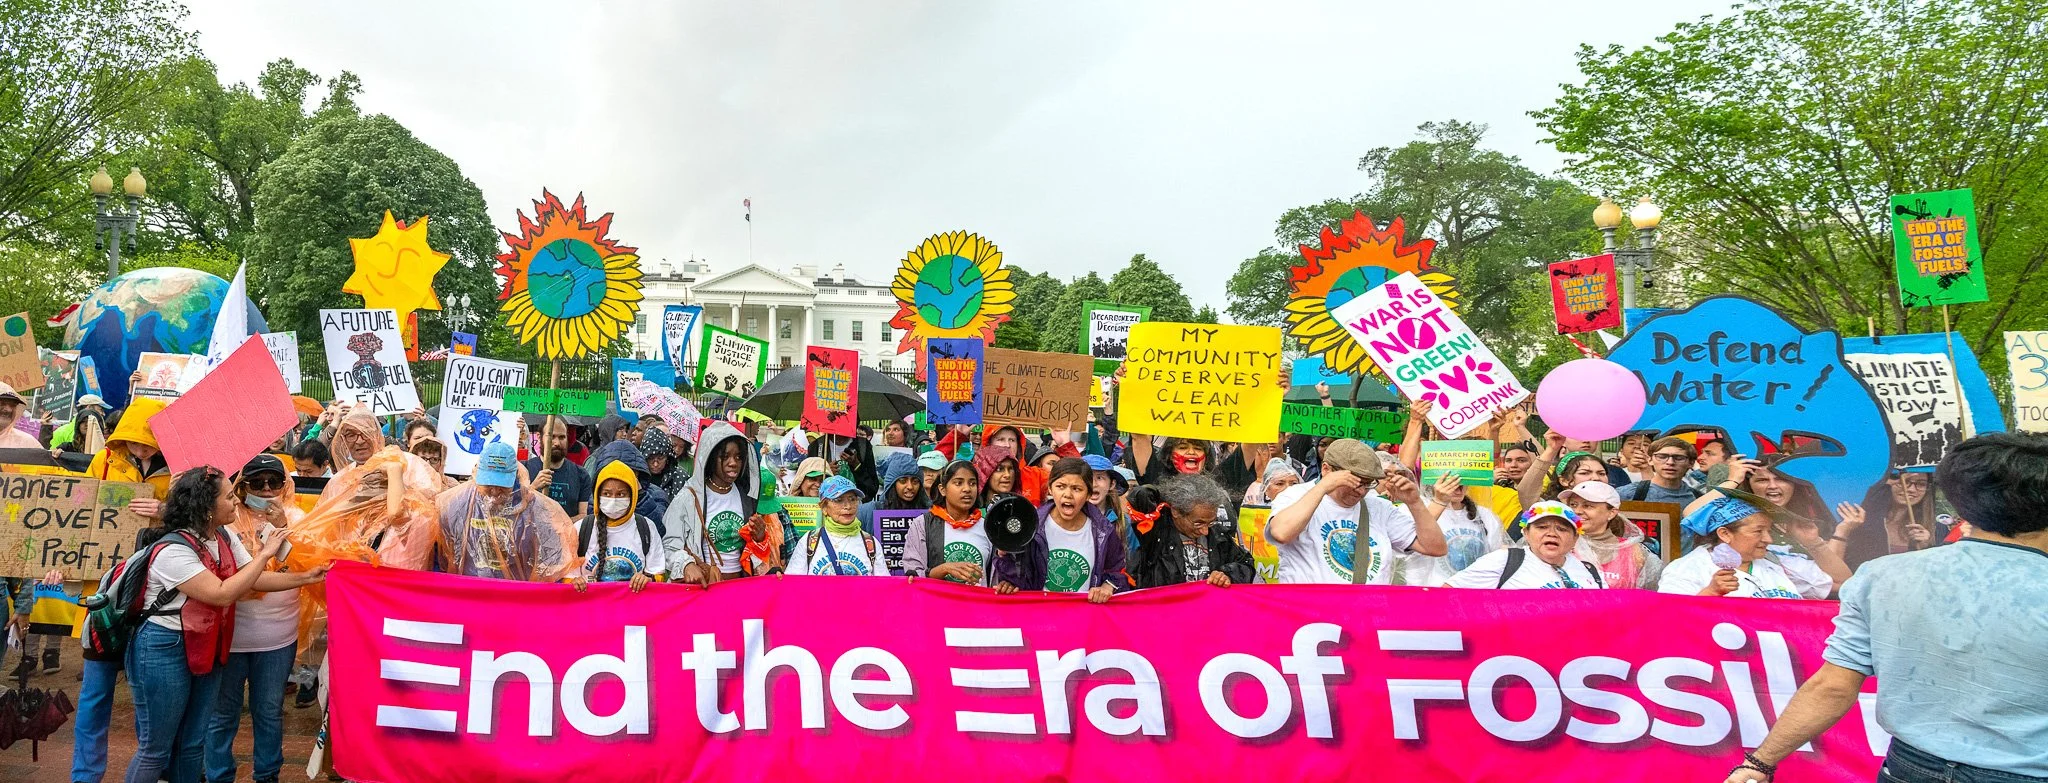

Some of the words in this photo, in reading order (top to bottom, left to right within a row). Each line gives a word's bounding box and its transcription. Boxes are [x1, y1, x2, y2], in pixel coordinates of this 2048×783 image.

[1907, 221, 1937, 235] END
[1939, 219, 1965, 232] THE
[1913, 234, 1944, 247] ERA
[1945, 233, 1962, 245] OF
[1915, 245, 1965, 260] FOSSIL
[1920, 259, 1963, 273] FUELS
[1563, 279, 1584, 289] END
[1586, 275, 1606, 284] THE
[1567, 286, 1589, 296] ERA
[1591, 283, 1604, 292] OF
[1568, 292, 1605, 304] FOSSIL
[1349, 300, 1411, 335] WAR
[1406, 288, 1432, 308] IS
[1572, 301, 1604, 312] FUELS
[323, 313, 341, 331] A
[341, 310, 394, 332] FUTURE
[1097, 321, 1130, 332] DECOLONI
[1181, 328, 1218, 343] MY
[1370, 307, 1451, 363] NOT
[716, 335, 757, 355] CLIMATE
[1651, 330, 1806, 368] Defend
[714, 345, 752, 362] JUSTICE
[1127, 347, 1278, 370] COMMUNITY
[1396, 332, 1477, 382] GREEN!
[722, 356, 746, 369] NOW
[936, 360, 956, 370] END
[957, 360, 976, 370] THE
[333, 365, 379, 391] FOSSIL
[382, 364, 410, 386] FUEL
[457, 363, 485, 381] YOU
[488, 367, 523, 387] CAN'T
[815, 369, 833, 380] END
[834, 370, 851, 382] THE
[939, 371, 959, 380] ERA
[960, 371, 973, 380] OF
[983, 360, 1000, 374] HE
[1006, 363, 1047, 378] CLIMATE
[1050, 368, 1079, 382] CRISIS
[1138, 367, 1261, 388] DESERVES
[453, 379, 476, 396] LIVE
[479, 382, 505, 400] WITH
[816, 379, 835, 389] ERA
[836, 381, 848, 391] OF
[939, 381, 973, 391] FOSSIL
[1015, 381, 1028, 396] IS
[1033, 382, 1043, 398] A
[1632, 364, 1834, 412] Water!
[1870, 379, 1948, 396] STICE
[356, 391, 405, 413] FAIL
[505, 387, 549, 399] ANOTHER
[554, 390, 590, 401] WORLD
[817, 389, 847, 401] FOSSIL
[941, 390, 971, 400] FUELS
[1157, 388, 1240, 407] CLEAN
[515, 401, 525, 410] IS
[533, 402, 577, 414] POSSBLE
[818, 399, 846, 410] FUELS
[986, 394, 1037, 417] HUMAN
[1040, 399, 1080, 422] CRISIS
[1439, 382, 1519, 430] CODEPINK
[1881, 397, 1938, 413] NOW
[1150, 409, 1241, 428] WATER
[1283, 405, 1341, 420] ANOTHER
[1351, 410, 1402, 424] WORLD
[1291, 422, 1302, 433] IS
[1311, 423, 1375, 439] POSSIBLE
[23, 507, 119, 530] OVER
[718, 513, 729, 521] FOR
[730, 513, 744, 526] FUTU
[883, 518, 905, 528] End
[883, 532, 902, 541] Era
[884, 545, 904, 554] Fos
[949, 543, 964, 552] FOR
[966, 545, 982, 565] FUTUR
[812, 555, 833, 575] CLIMAT
[838, 551, 869, 575] DEFENDER
[885, 558, 904, 567] Fue
[376, 617, 650, 737] End
[682, 619, 913, 733] the
[944, 627, 1167, 737] Era
[1199, 622, 1344, 740] of
[1377, 622, 1815, 752] Fossil
